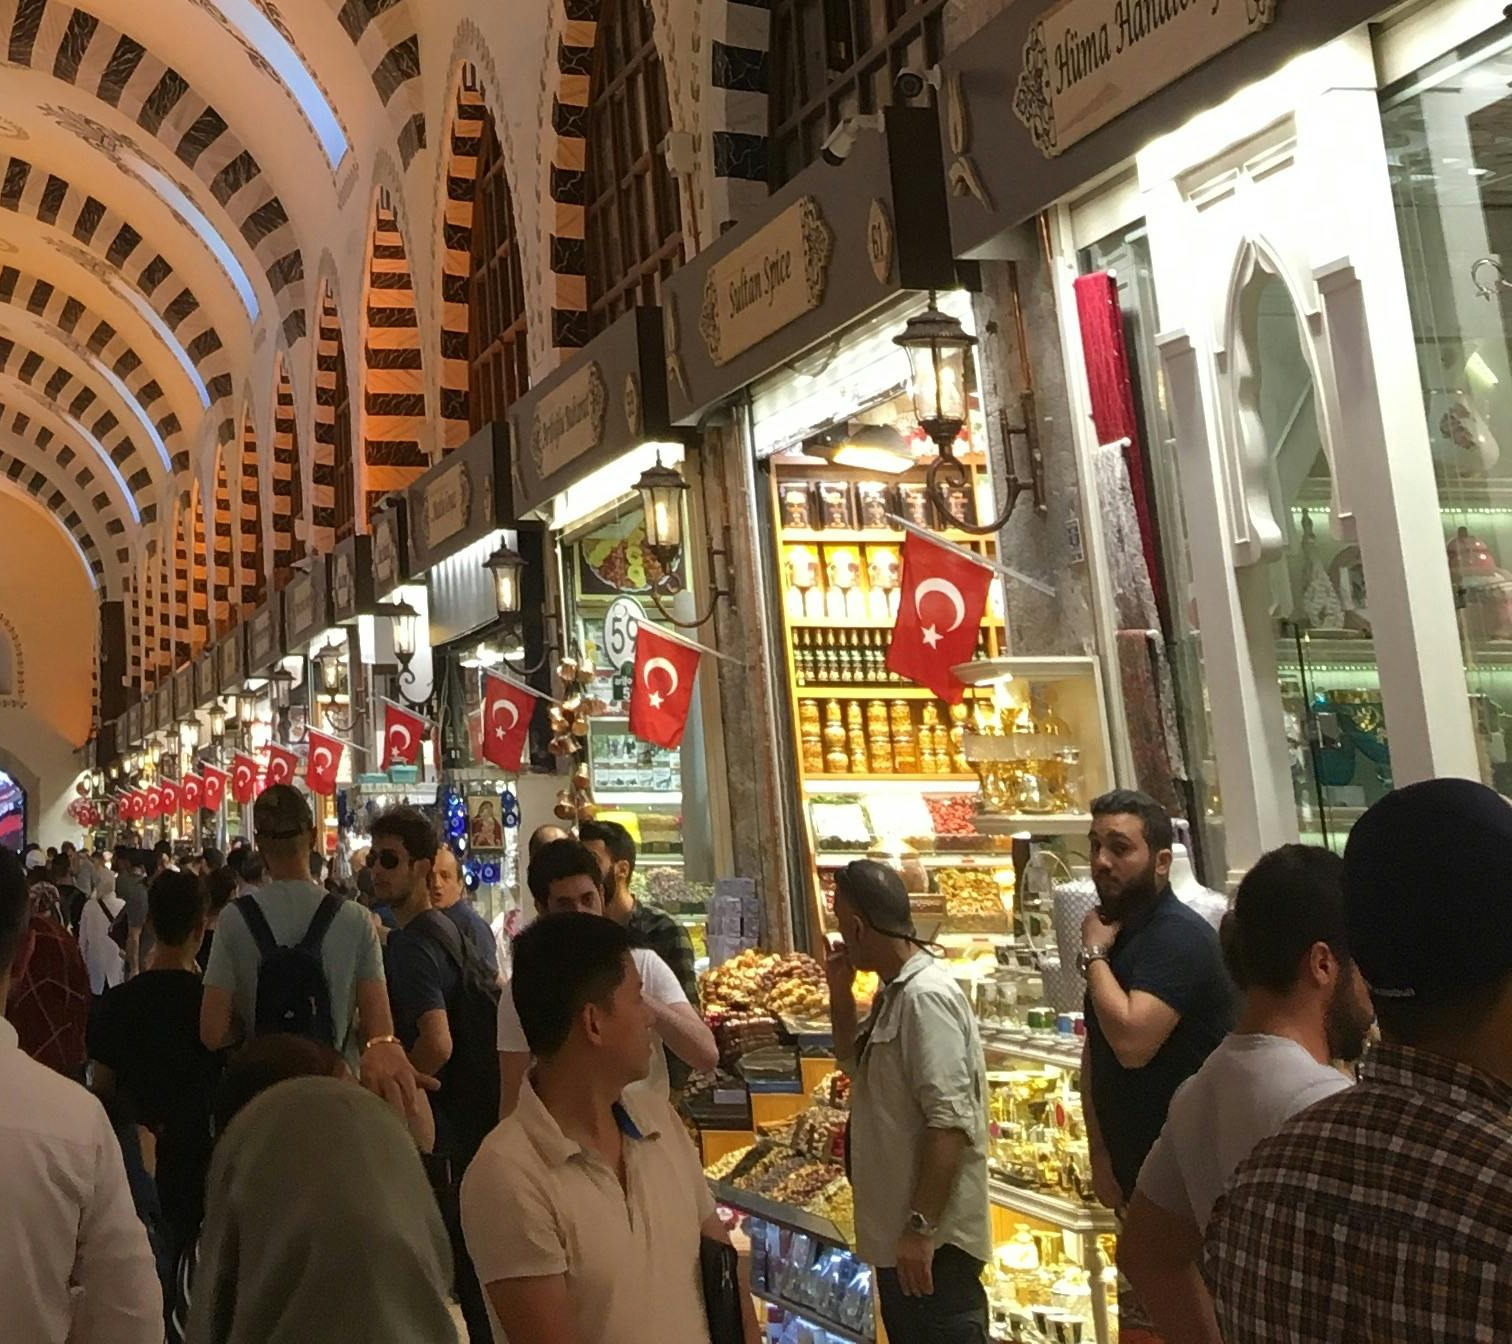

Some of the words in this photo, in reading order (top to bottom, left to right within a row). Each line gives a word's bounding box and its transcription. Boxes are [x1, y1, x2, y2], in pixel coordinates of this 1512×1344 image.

[1054, 23, 1112, 95] Hüma
[871, 222, 885, 260] 61
[729, 266, 763, 320] Sultan
[764, 247, 791, 308] Spice
[612, 616, 639, 654] 59
